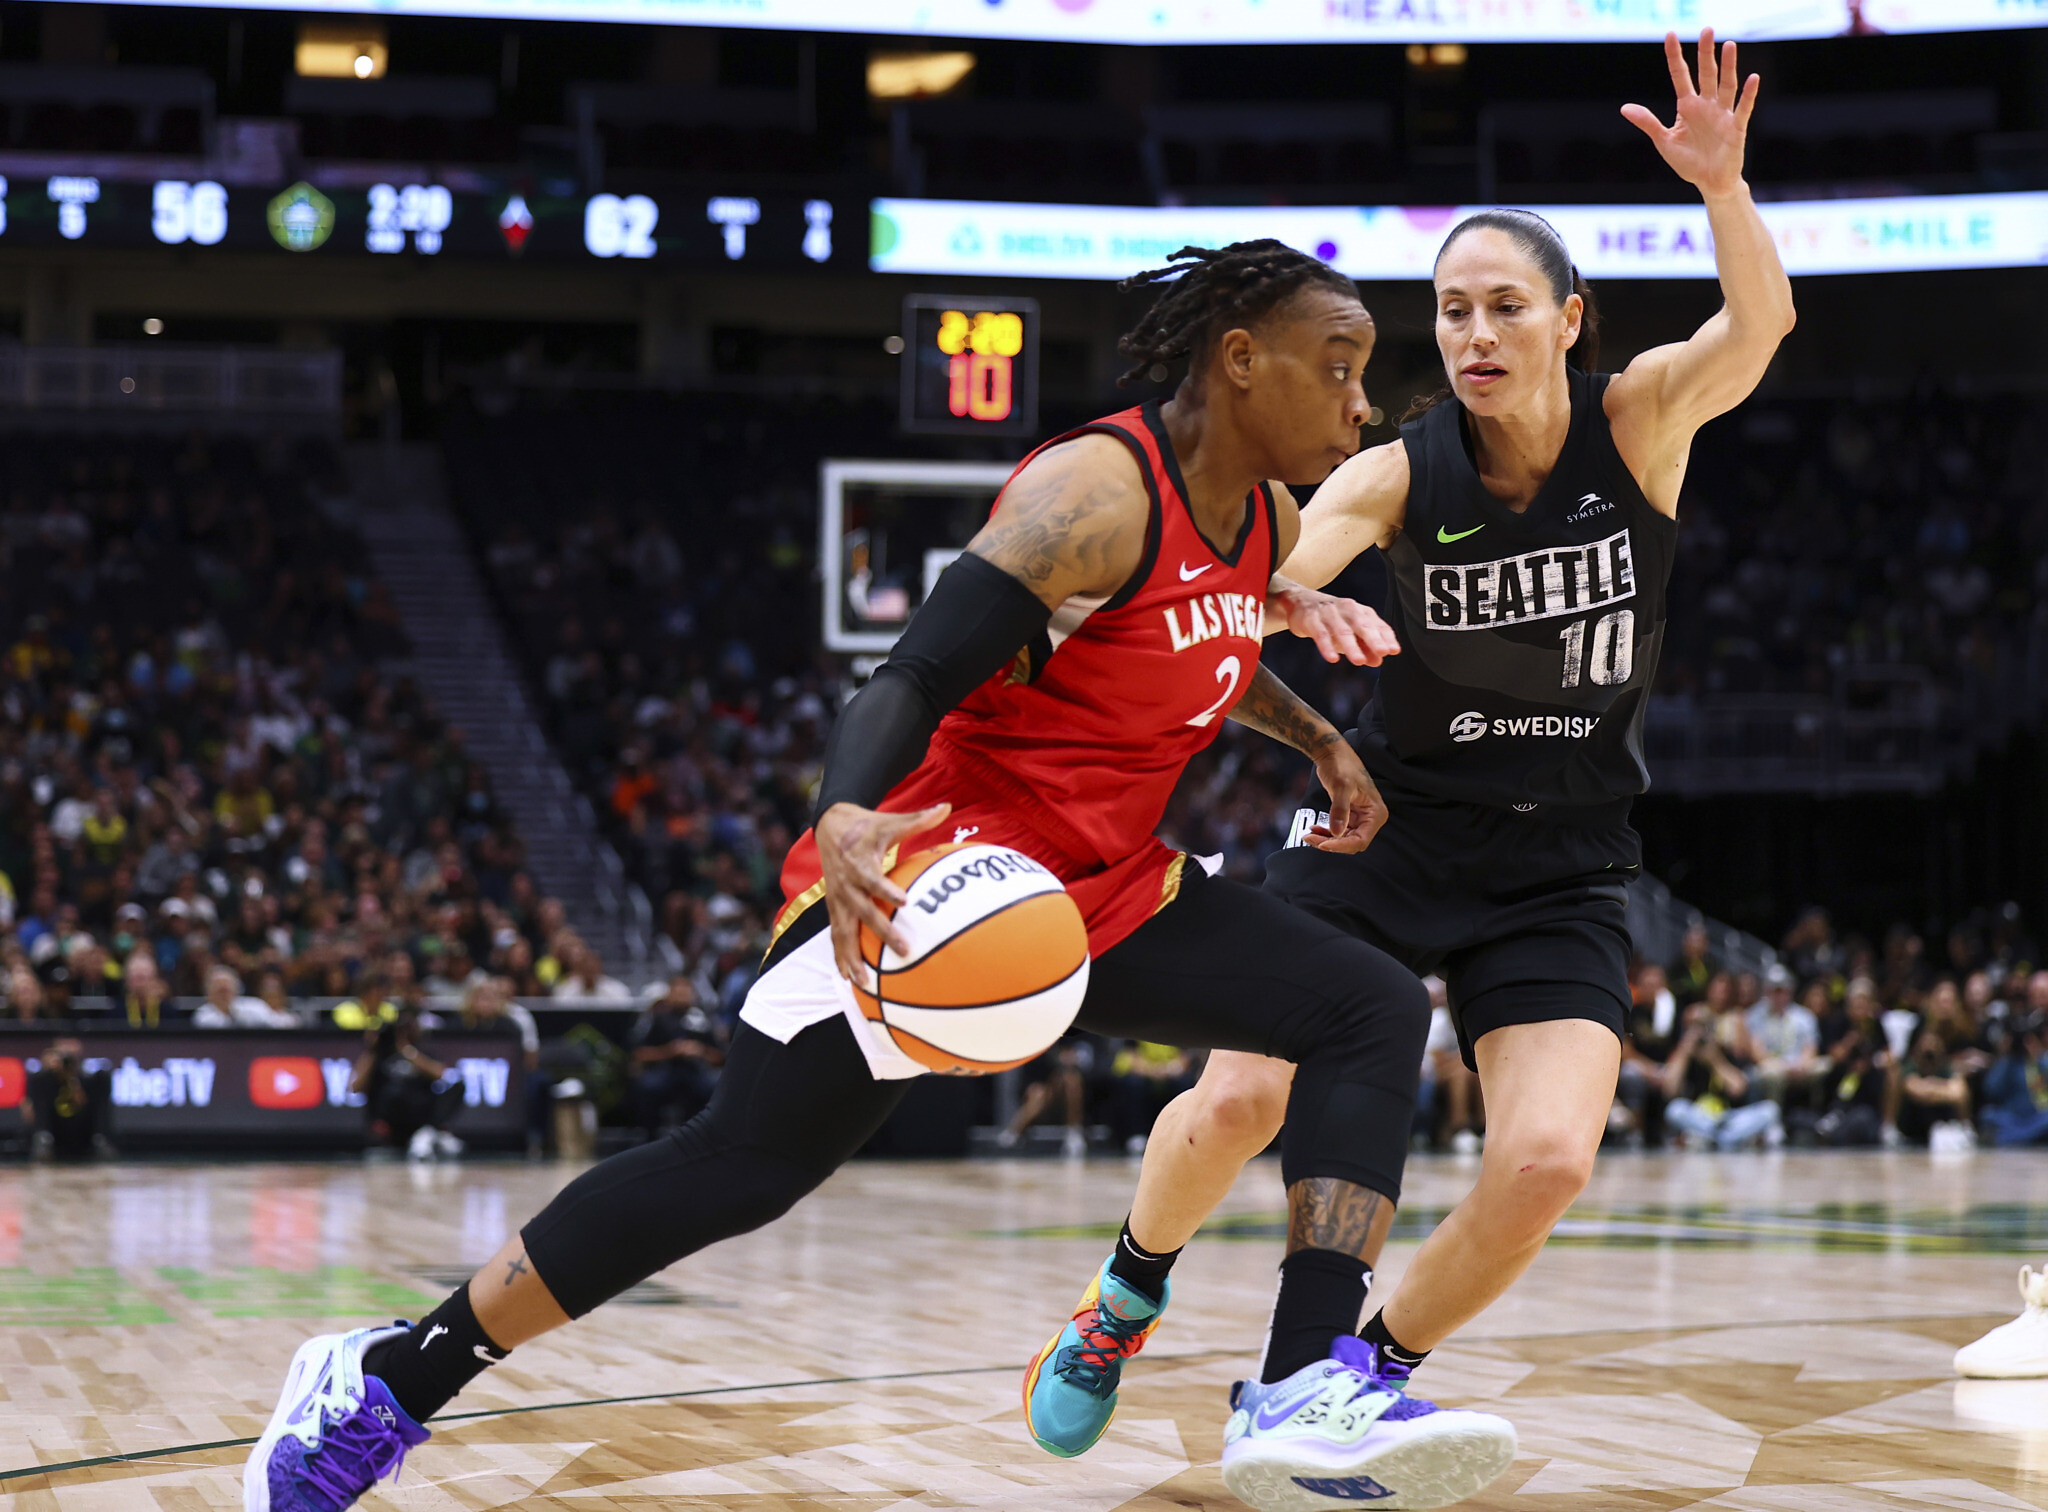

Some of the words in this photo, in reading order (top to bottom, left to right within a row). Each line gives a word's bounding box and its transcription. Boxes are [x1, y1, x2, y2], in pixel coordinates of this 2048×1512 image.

[152, 181, 228, 245] 56
[584, 194, 659, 258] 62
[1851, 217, 1994, 252] SMILE
[949, 354, 1012, 420] 10
[1566, 502, 1615, 523] SYMETRA
[1428, 534, 1632, 627] SEATTLE
[1162, 593, 1222, 653] LAS
[1216, 593, 1265, 647] VEGA
[1559, 609, 1635, 689] 10
[1185, 655, 1241, 727] 2
[913, 854, 1047, 915] Wilson
